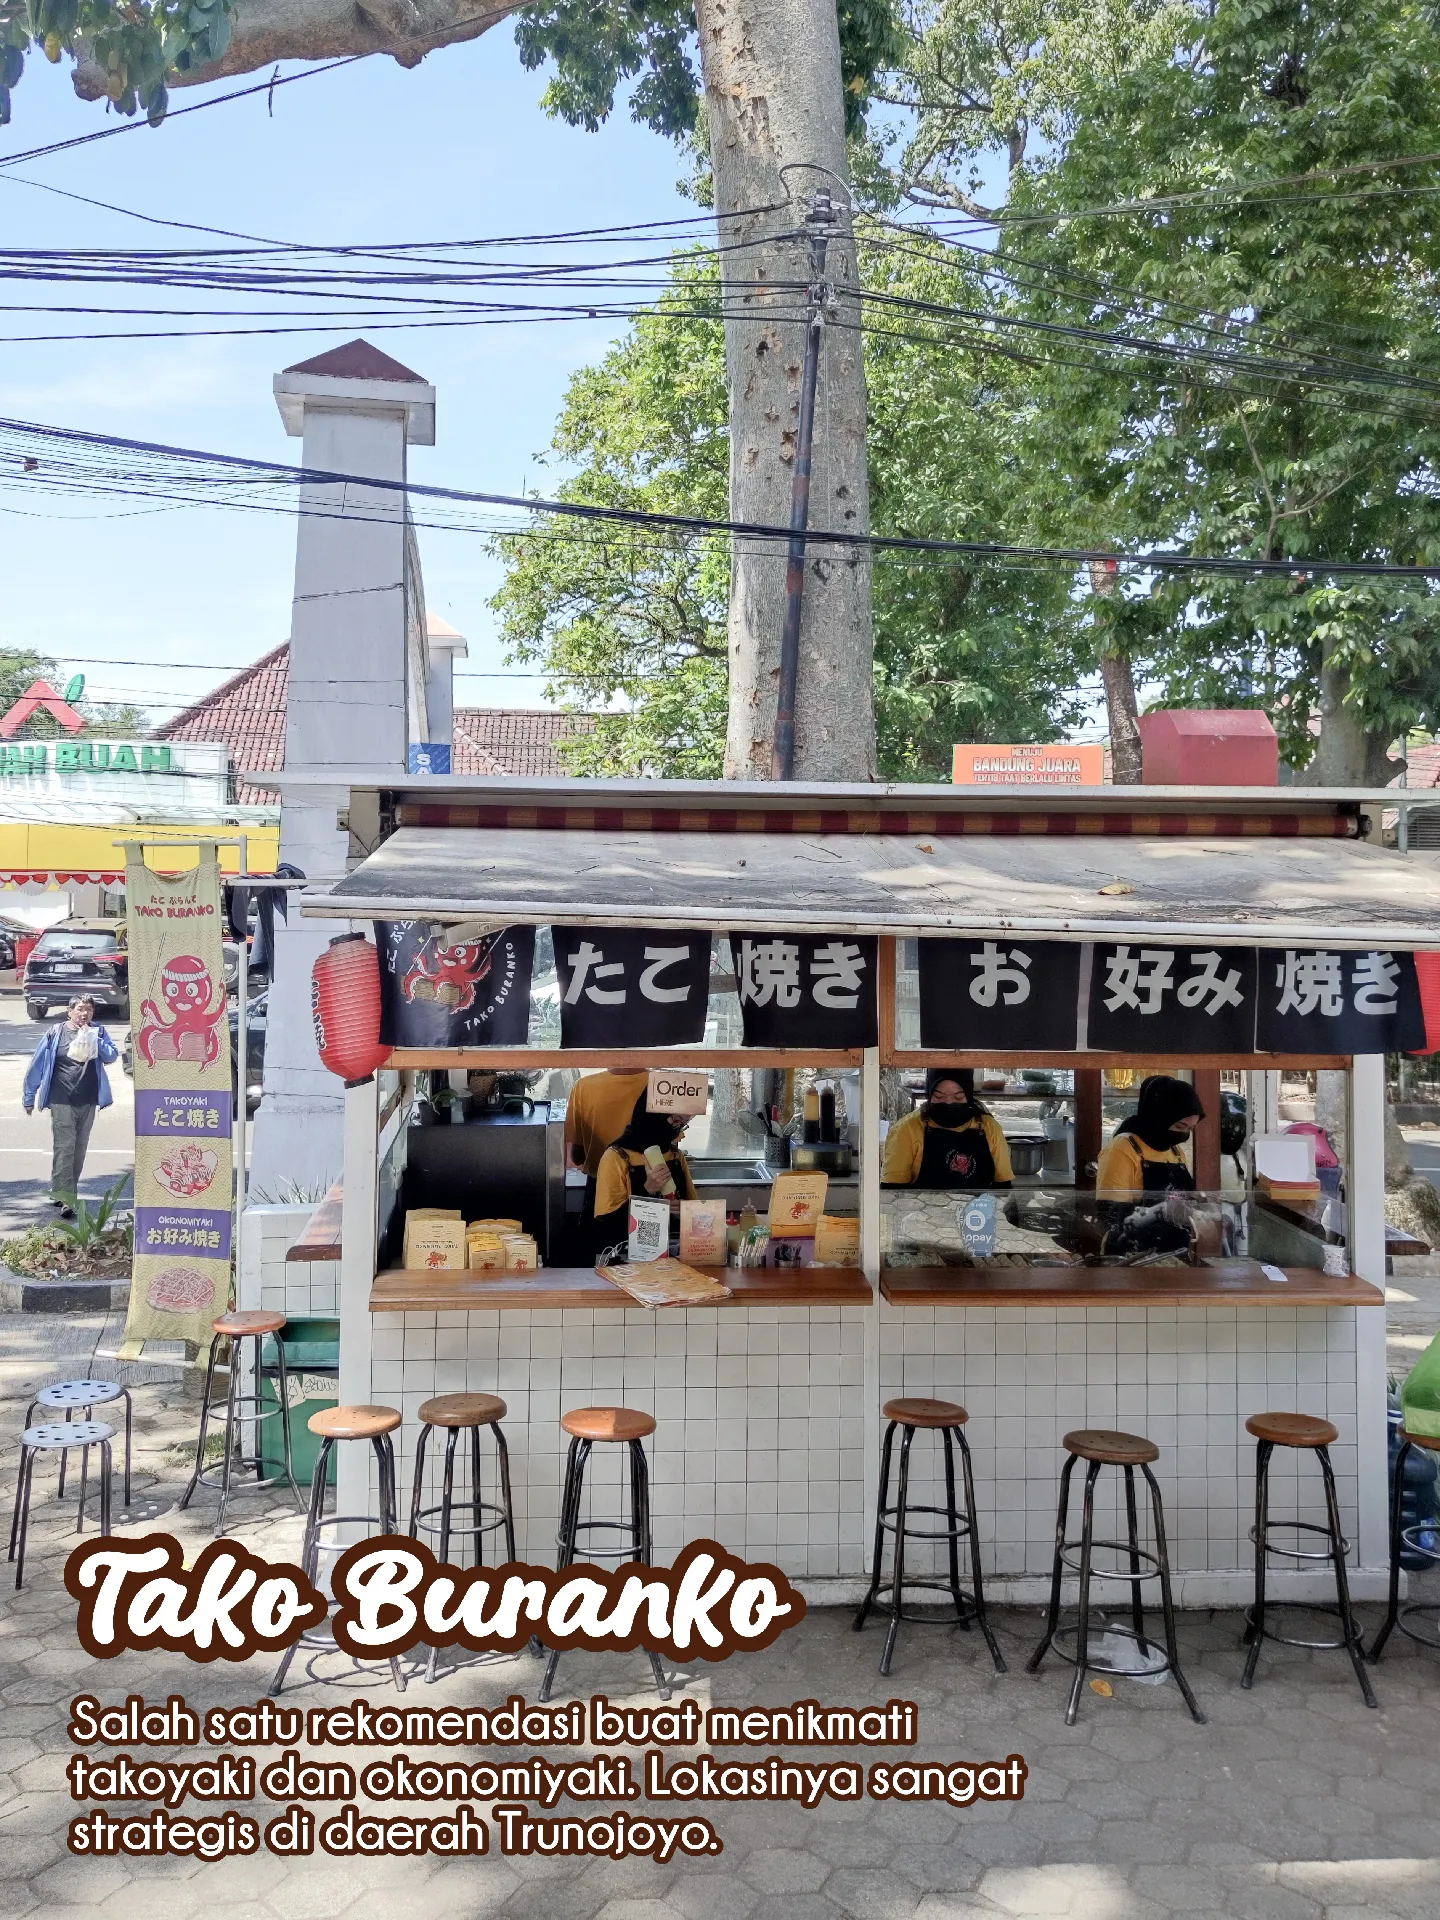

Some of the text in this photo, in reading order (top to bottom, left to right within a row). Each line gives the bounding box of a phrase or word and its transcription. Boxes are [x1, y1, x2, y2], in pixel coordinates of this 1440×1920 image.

[1011, 747, 1043, 757] MENUJU
[0, 743, 171, 776] AH BUAH
[973, 758, 1081, 772] BANDUNG JUARA
[1000, 774, 1018, 783] TAAT
[135, 905, 163, 918] TAKO
[464, 942, 516, 1030] TAKO BURANKO
[657, 1080, 703, 1097] Order
[163, 1096, 208, 1106] TAKOYAKI
[655, 1099, 674, 1107] HERE
[153, 1107, 220, 1129] たこ焼き
[158, 1215, 213, 1227] OKONOMIYAKI
[147, 1228, 221, 1249] お好み焼き
